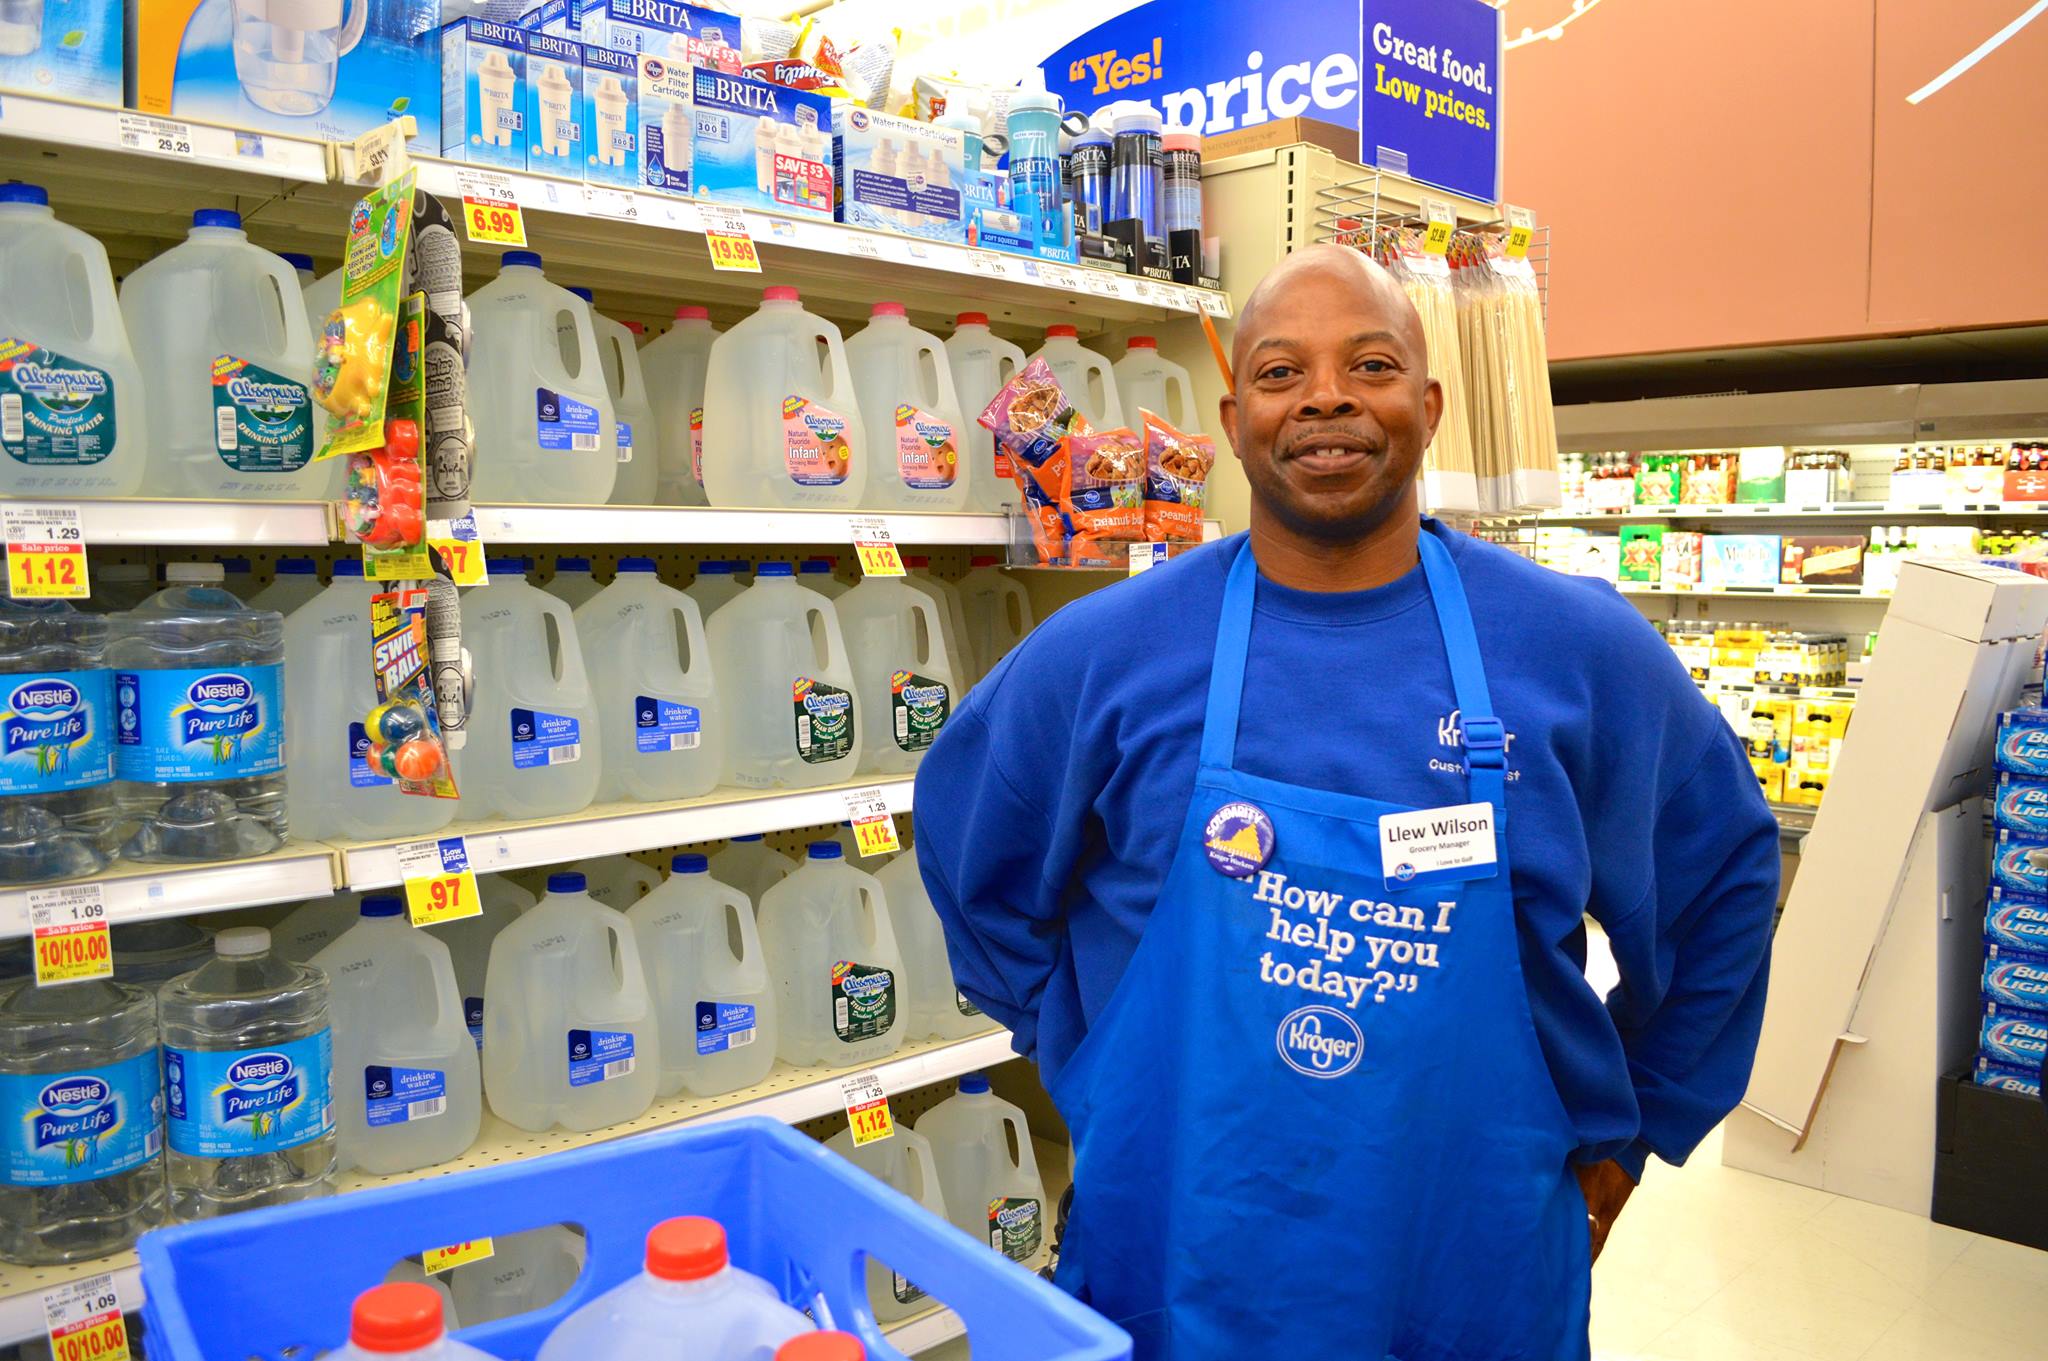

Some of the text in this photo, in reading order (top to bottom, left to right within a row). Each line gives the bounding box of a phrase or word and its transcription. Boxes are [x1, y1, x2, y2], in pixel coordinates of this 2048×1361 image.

[631, 0, 692, 30] BRITA
[483, 23, 523, 44] BRITA
[541, 36, 580, 57] BRITA
[688, 40, 736, 63] SAVE $3
[598, 49, 635, 69] BRITA
[1372, 22, 1493, 94] Great food.
[667, 65, 689, 78] Water
[652, 84, 690, 99] Cartridge
[668, 77, 689, 89] Filter
[715, 76, 780, 113] BRITA
[1162, 50, 1359, 138] price
[1374, 63, 1491, 130] Low prices.
[872, 115, 958, 144] Water Filter Cartridges
[158, 139, 190, 153] 29.29
[1075, 149, 1106, 162] BRITA
[1173, 151, 1199, 164] BRITA
[776, 155, 824, 178] SAVE $3
[1017, 160, 1053, 174] BRITA
[489, 188, 515, 199] 7.99
[473, 208, 515, 235] 6.99
[984, 233, 997, 243] SOFT
[712, 239, 755, 262] 19.99
[1047, 247, 1070, 260] BRITA
[1150, 267, 1171, 280] BRITA
[17, 366, 103, 393] Absopure
[231, 380, 304, 404] Absopure
[565, 405, 593, 416] drinking
[25, 411, 104, 435] DRINKING WATER
[238, 422, 304, 444] DRINKING WATER
[788, 430, 809, 438] Natural
[789, 447, 819, 459] Infant
[902, 452, 929, 464] Infant
[1093, 516, 1129, 530] peanut
[1160, 509, 1192, 522] peanut
[46, 527, 80, 539] 1.29
[872, 531, 890, 540] 1.29
[22, 544, 70, 553] Sale price
[865, 550, 896, 568] 1.12
[21, 557, 76, 585] 1.12
[387, 648, 422, 693] BALL
[21, 689, 72, 706] Nestlé
[197, 683, 245, 699] Nestlé
[664, 707, 692, 717] drinking
[10, 718, 81, 745] Pure Life
[188, 711, 254, 735] Pure Life
[541, 718, 571, 729] drinking
[547, 725, 567, 734] water
[869, 802, 886, 813] 1.29
[1206, 805, 1266, 838] SOLIDARITY
[1388, 818, 1488, 842] Llew Wilson
[861, 824, 891, 847] 1.12
[442, 848, 462, 857] Low
[1409, 840, 1470, 854] Grocery Manager
[443, 853, 465, 864] price
[427, 878, 460, 911] .97
[72, 904, 103, 920] 1.09
[1349, 898, 1426, 932] can
[1432, 901, 1456, 933] I
[48, 923, 94, 936] Sale price
[2003, 919, 2048, 936] LIGH
[1266, 907, 1440, 969] help you
[40, 934, 108, 967] 10/10.00
[2002, 977, 2048, 994] LIGH
[722, 1006, 749, 1018] drinking
[727, 1013, 745, 1021] water
[598, 1035, 627, 1047] drinking
[603, 1041, 622, 1050] water
[1289, 1015, 1356, 1069] Kroger
[1998, 1035, 2047, 1050] LIGH
[236, 1059, 284, 1079] Nestlé
[400, 1072, 436, 1085] drinking
[407, 1079, 430, 1088] water
[49, 1084, 100, 1103] Nestlé
[228, 1085, 293, 1113] Pure Life
[866, 1087, 883, 1100] 1.29
[41, 1111, 111, 1139] Pure Life
[856, 1110, 886, 1135] 1.12
[85, 1293, 116, 1313] 1.09
[64, 1314, 109, 1333] Sale price
[58, 1324, 124, 1361] 10/10.00
